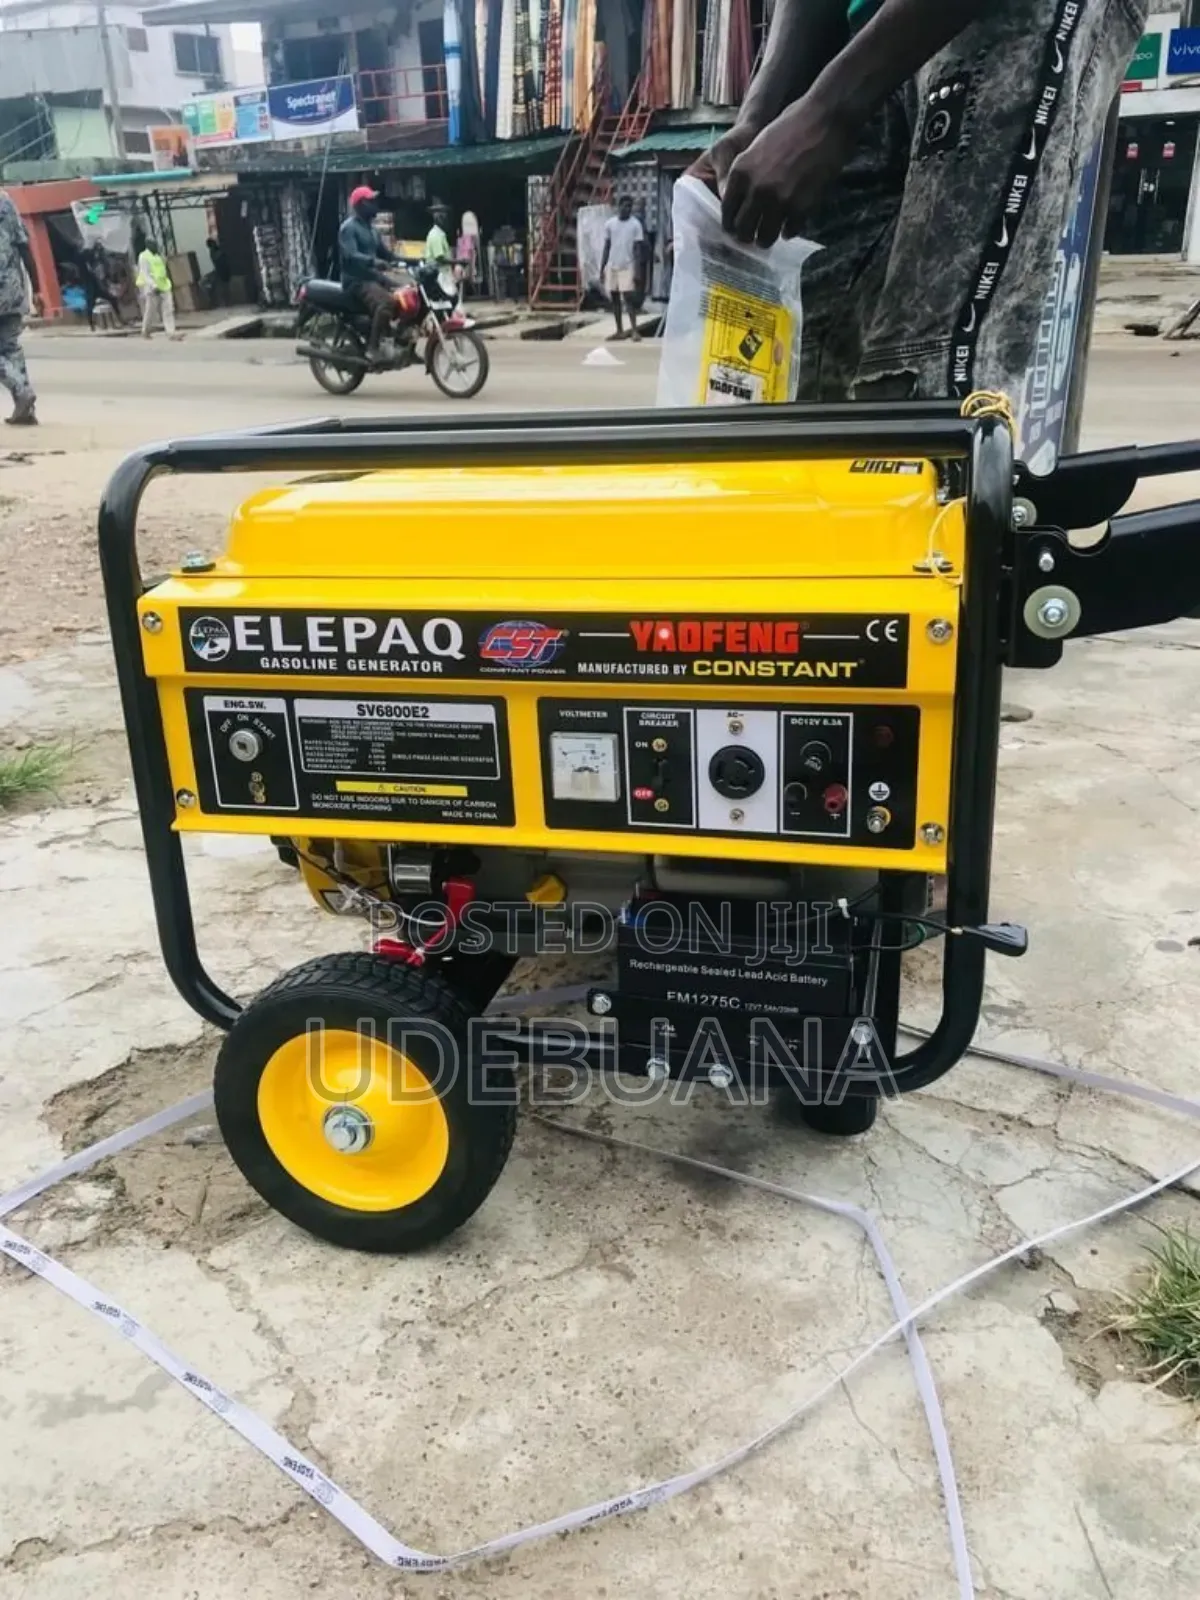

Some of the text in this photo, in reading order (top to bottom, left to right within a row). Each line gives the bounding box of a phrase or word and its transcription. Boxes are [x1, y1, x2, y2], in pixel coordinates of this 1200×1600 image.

[1055, 1, 1079, 41] NIKEI
[1034, 85, 1057, 126] NIKEI
[1005, 174, 1028, 214] NIKEI
[974, 261, 1000, 300] NIKEI
[954, 345, 970, 382] NIKEI
[233, 615, 466, 660] ELEPAQ
[480, 628, 563, 660] CST
[629, 620, 801, 654] YAOFENG
[260, 657, 443, 673] GASOLINE GENERATOR
[479, 666, 529, 674] CONSTANT
[577, 660, 858, 678] MANUFACTURED BY CONSTANT
[356, 703, 430, 719] SV6800E2
[559, 709, 609, 718] VOLTMETER
[641, 712, 676, 720] CIRCUIT
[790, 718, 820, 726] DC12V
[629, 959, 828, 987] Rechargeable Sealed Lead Acid Battery
